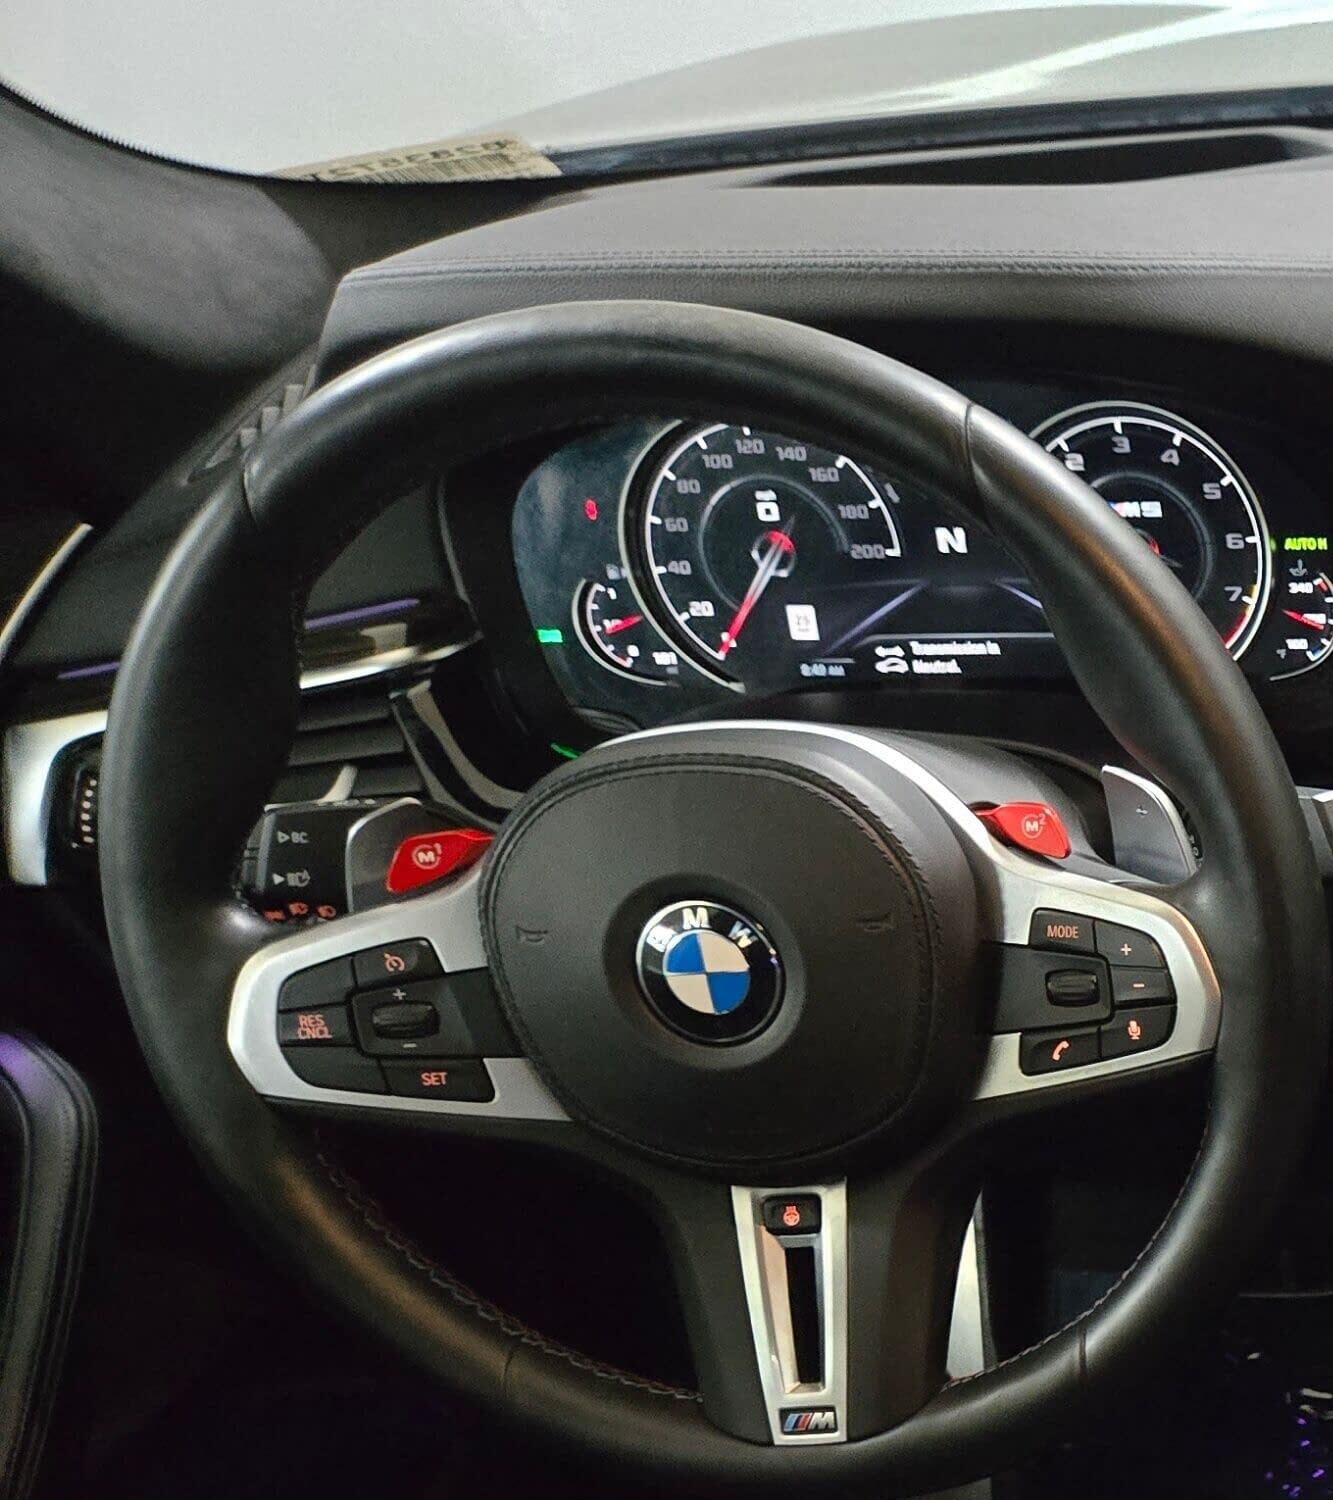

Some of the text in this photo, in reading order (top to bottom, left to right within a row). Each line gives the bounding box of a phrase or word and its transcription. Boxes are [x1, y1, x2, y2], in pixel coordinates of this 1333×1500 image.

[735, 438, 765, 456] 120
[1112, 436, 1131, 455] 3
[702, 453, 733, 470] 100
[775, 446, 808, 463] 140
[1064, 452, 1085, 472] 2
[1160, 448, 1180, 467] 4
[808, 467, 839, 483] 160
[1203, 482, 1221, 501] 5
[664, 517, 689, 533] 60
[934, 526, 968, 553] N
[1225, 533, 1244, 550] 6
[1284, 537, 1317, 550] AUTO
[850, 543, 887, 560] 200
[667, 559, 692, 576] 40
[1223, 585, 1243, 602] 7
[688, 600, 715, 617] 20
[647, 907, 758, 951] BMW
[1046, 924, 1079, 939] MODE
[299, 1014, 325, 1027] RES
[298, 1026, 332, 1039] CNCL
[421, 1071, 448, 1086] SET
